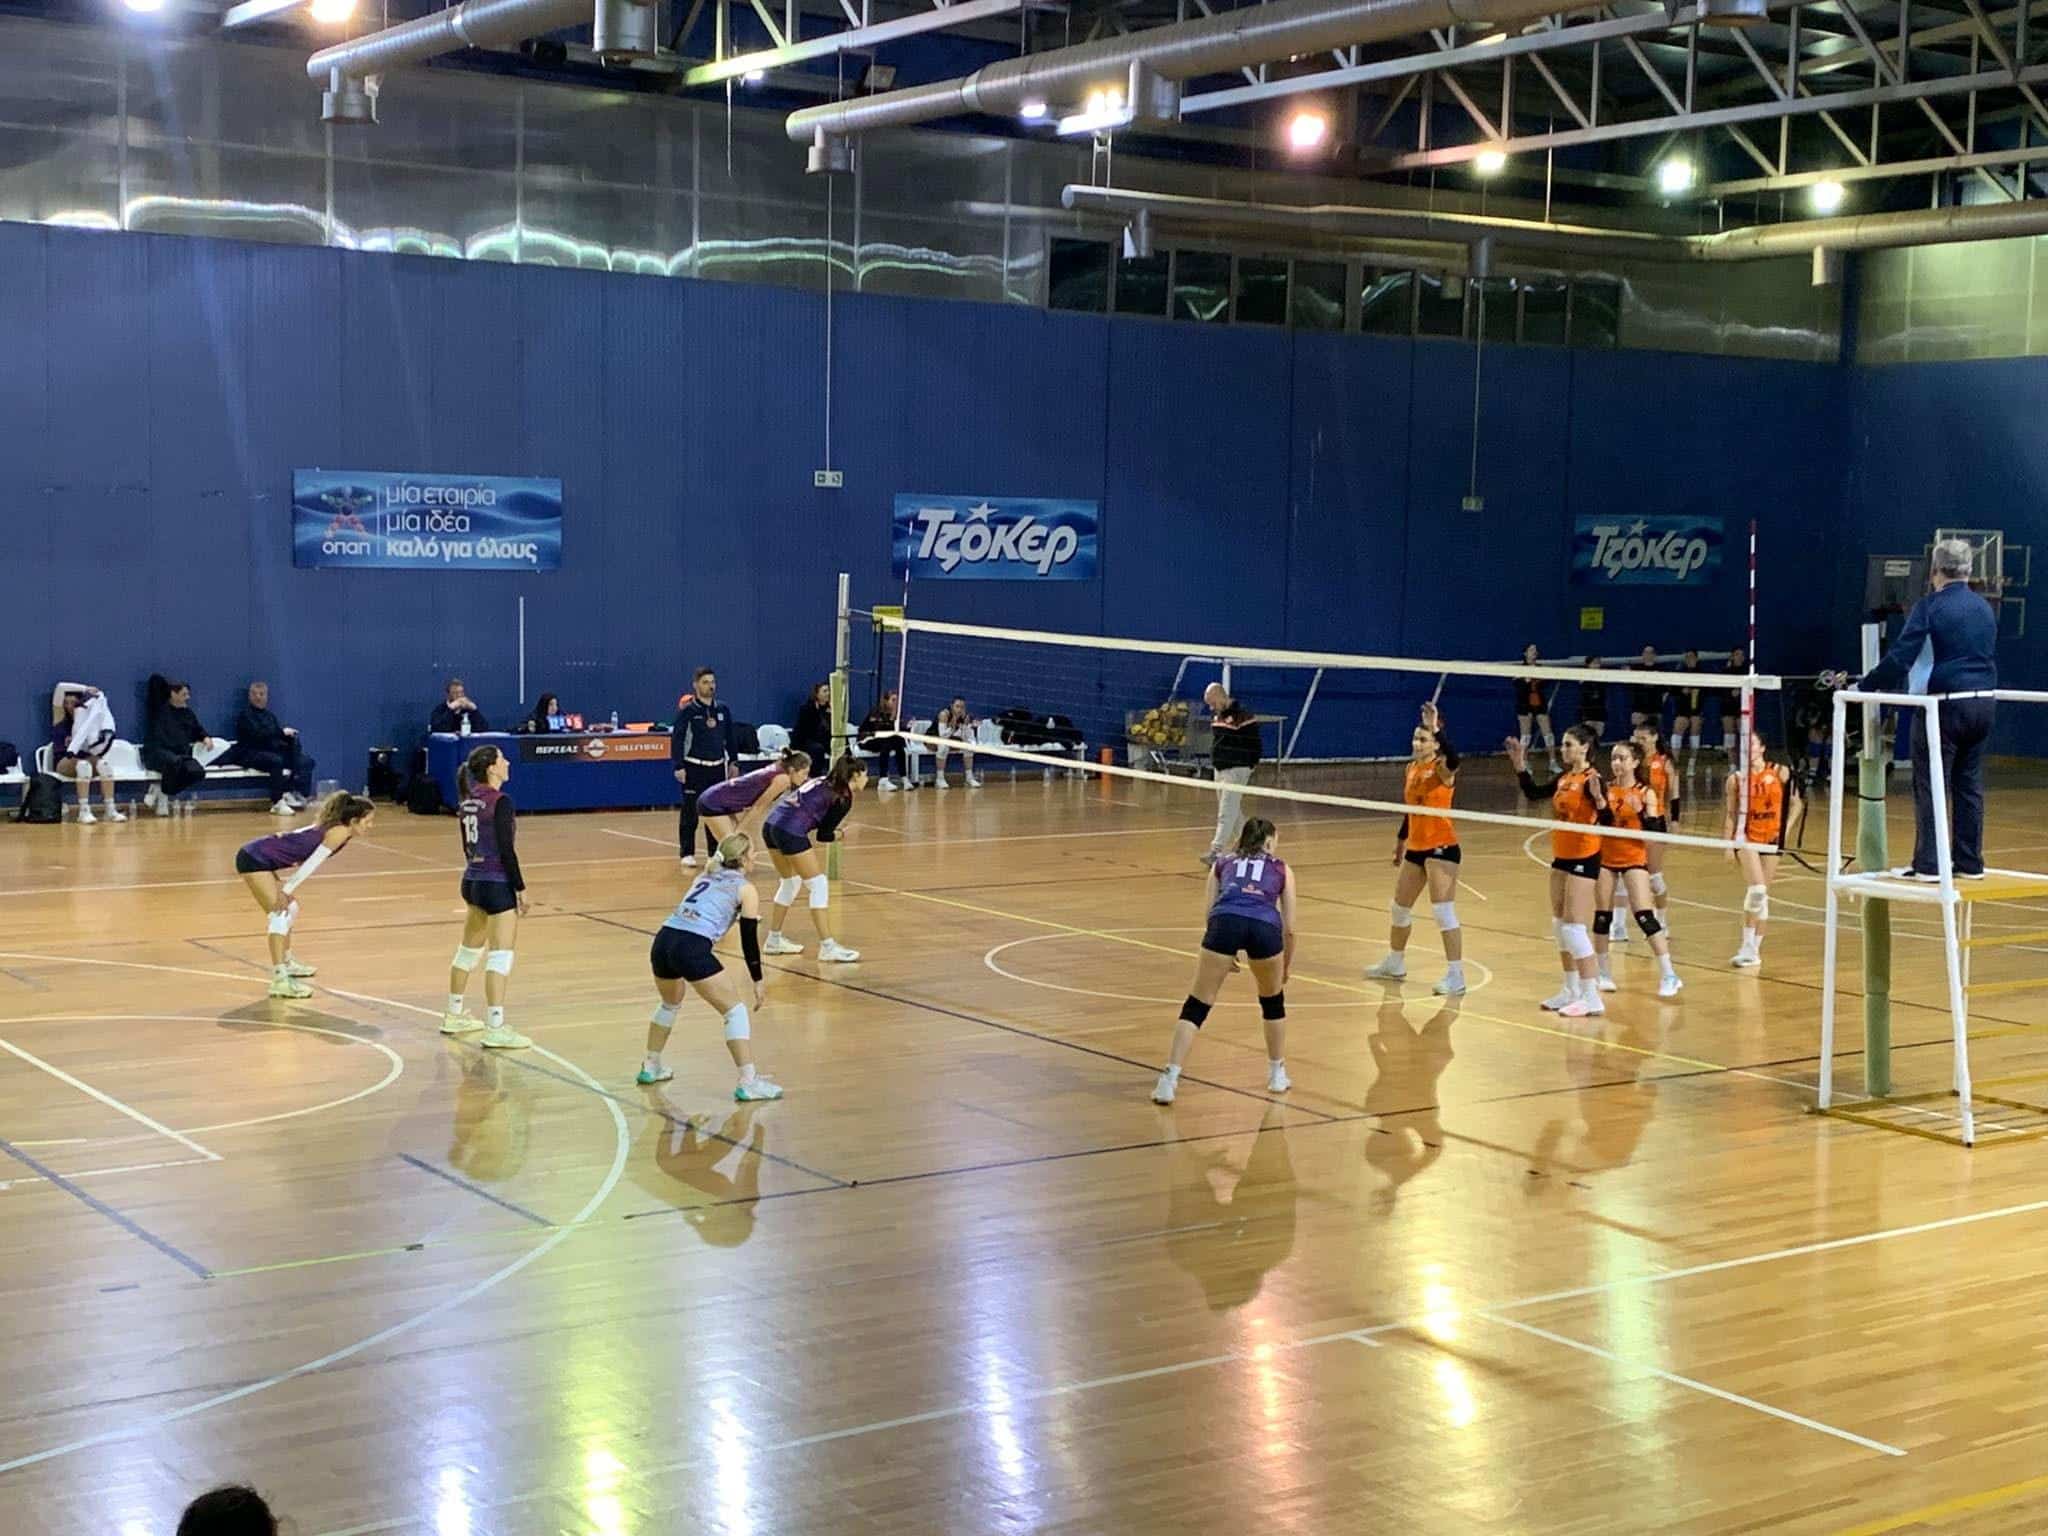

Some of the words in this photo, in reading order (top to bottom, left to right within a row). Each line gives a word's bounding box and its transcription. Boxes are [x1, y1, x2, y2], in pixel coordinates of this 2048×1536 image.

[386, 481, 420, 507] μία
[424, 483, 496, 509] εταιρία
[386, 509, 420, 536] μία
[425, 509, 470, 532] ιδέα
[387, 536, 439, 557] καλό
[441, 539, 472, 562] για
[476, 537, 538, 563] όλους
[462, 815, 478, 843] 13
[1233, 858, 1265, 882] 11
[684, 881, 710, 903] 2
